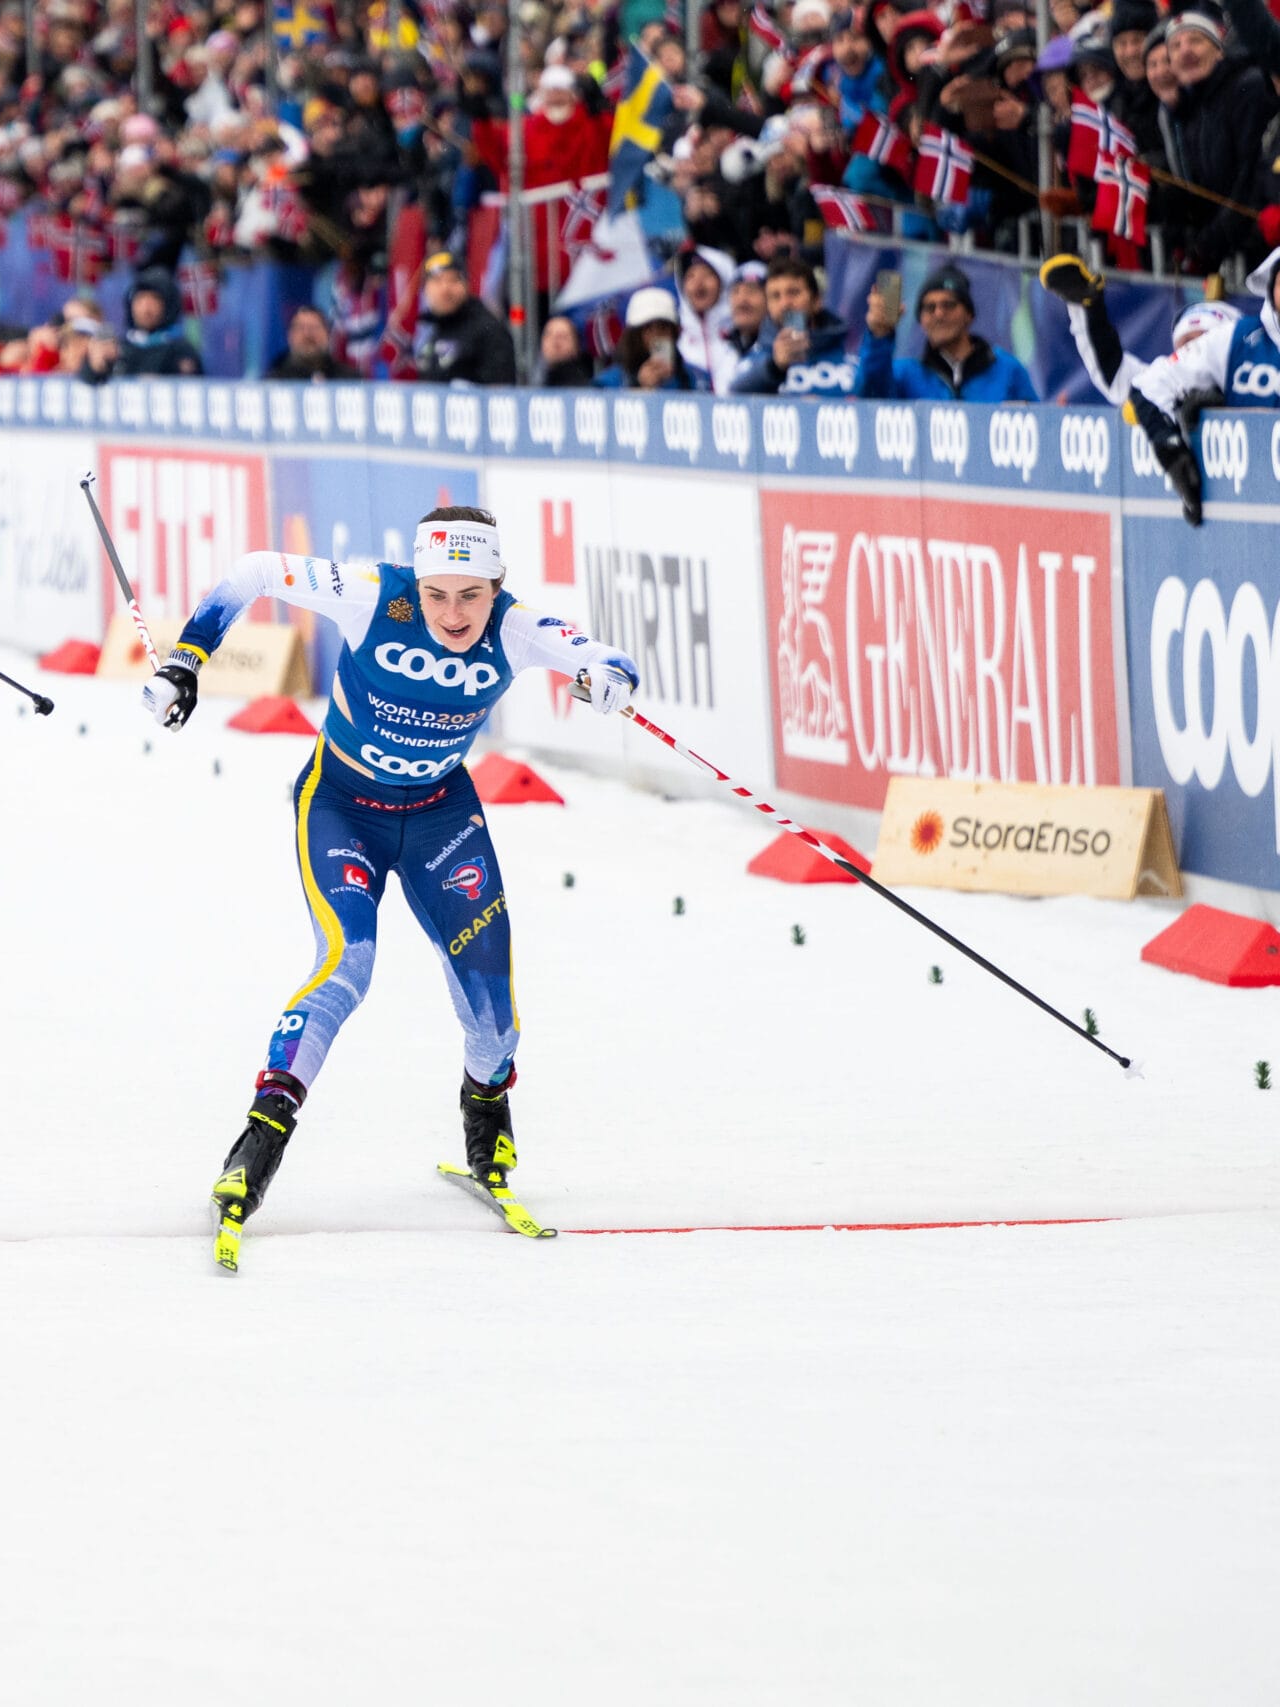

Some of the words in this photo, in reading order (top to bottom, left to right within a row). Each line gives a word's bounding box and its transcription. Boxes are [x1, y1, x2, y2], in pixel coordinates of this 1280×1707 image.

[989, 411, 1039, 483] coop
[1060, 414, 1109, 488] coop
[1202, 419, 1248, 495] coop
[450, 534, 488, 545] SVENSKA
[450, 541, 470, 549] SPEL
[375, 642, 500, 695] coop
[846, 531, 1096, 787] GENERALI
[368, 692, 436, 722] WORLD
[1151, 576, 1280, 855] coo
[360, 744, 461, 777] coop
[425, 825, 475, 872] Sundström
[950, 816, 1111, 857] StoraEnso
[443, 871, 477, 890] Thermia
[450, 901, 502, 955] CRAFT
